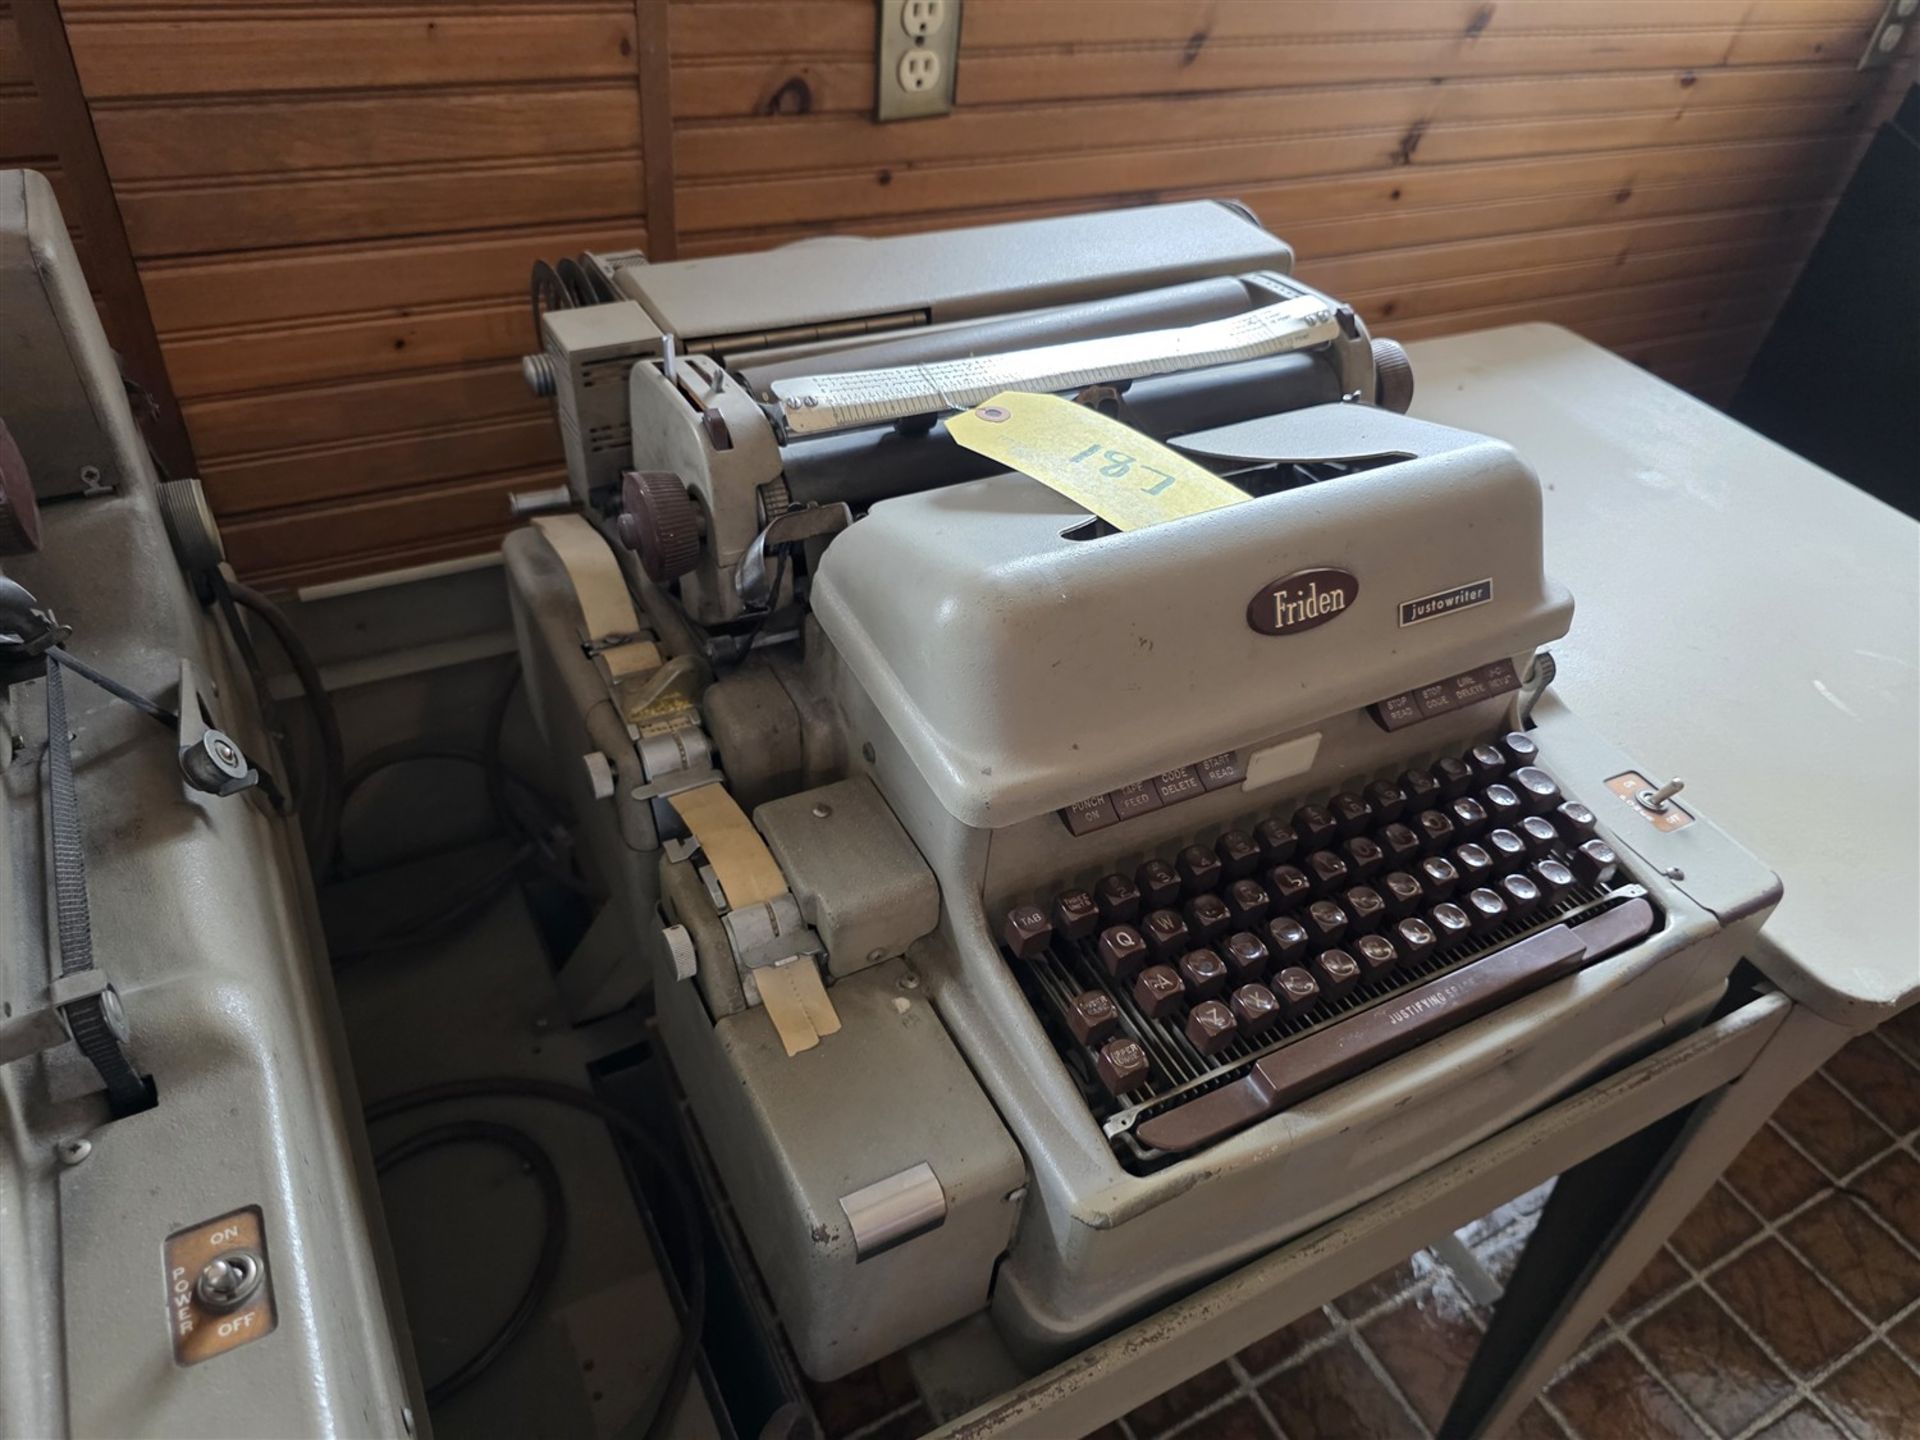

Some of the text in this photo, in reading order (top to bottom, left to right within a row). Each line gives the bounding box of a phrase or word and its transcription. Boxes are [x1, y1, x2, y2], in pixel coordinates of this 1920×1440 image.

[1069, 443, 1177, 496] 187
[1272, 581, 1346, 629] Friden
[1410, 587, 1484, 620] justowriter
[1203, 753, 1231, 771] START
[1161, 767, 1188, 784] CODE
[1209, 765, 1235, 780] READ
[1161, 777, 1199, 797] DELETE
[1072, 795, 1105, 814] PUNCH
[1123, 793, 1150, 809] FEED
[1084, 809, 1101, 823] ON
[1020, 913, 1042, 927] TAB
[1157, 914, 1175, 930] W
[1116, 931, 1135, 947] Q
[1153, 972, 1174, 990] A
[1388, 992, 1446, 1025] JUSTIFYING
[209, 1225, 239, 1246] ON
[172, 1267, 195, 1336] POWER
[216, 1312, 256, 1338] OFF
